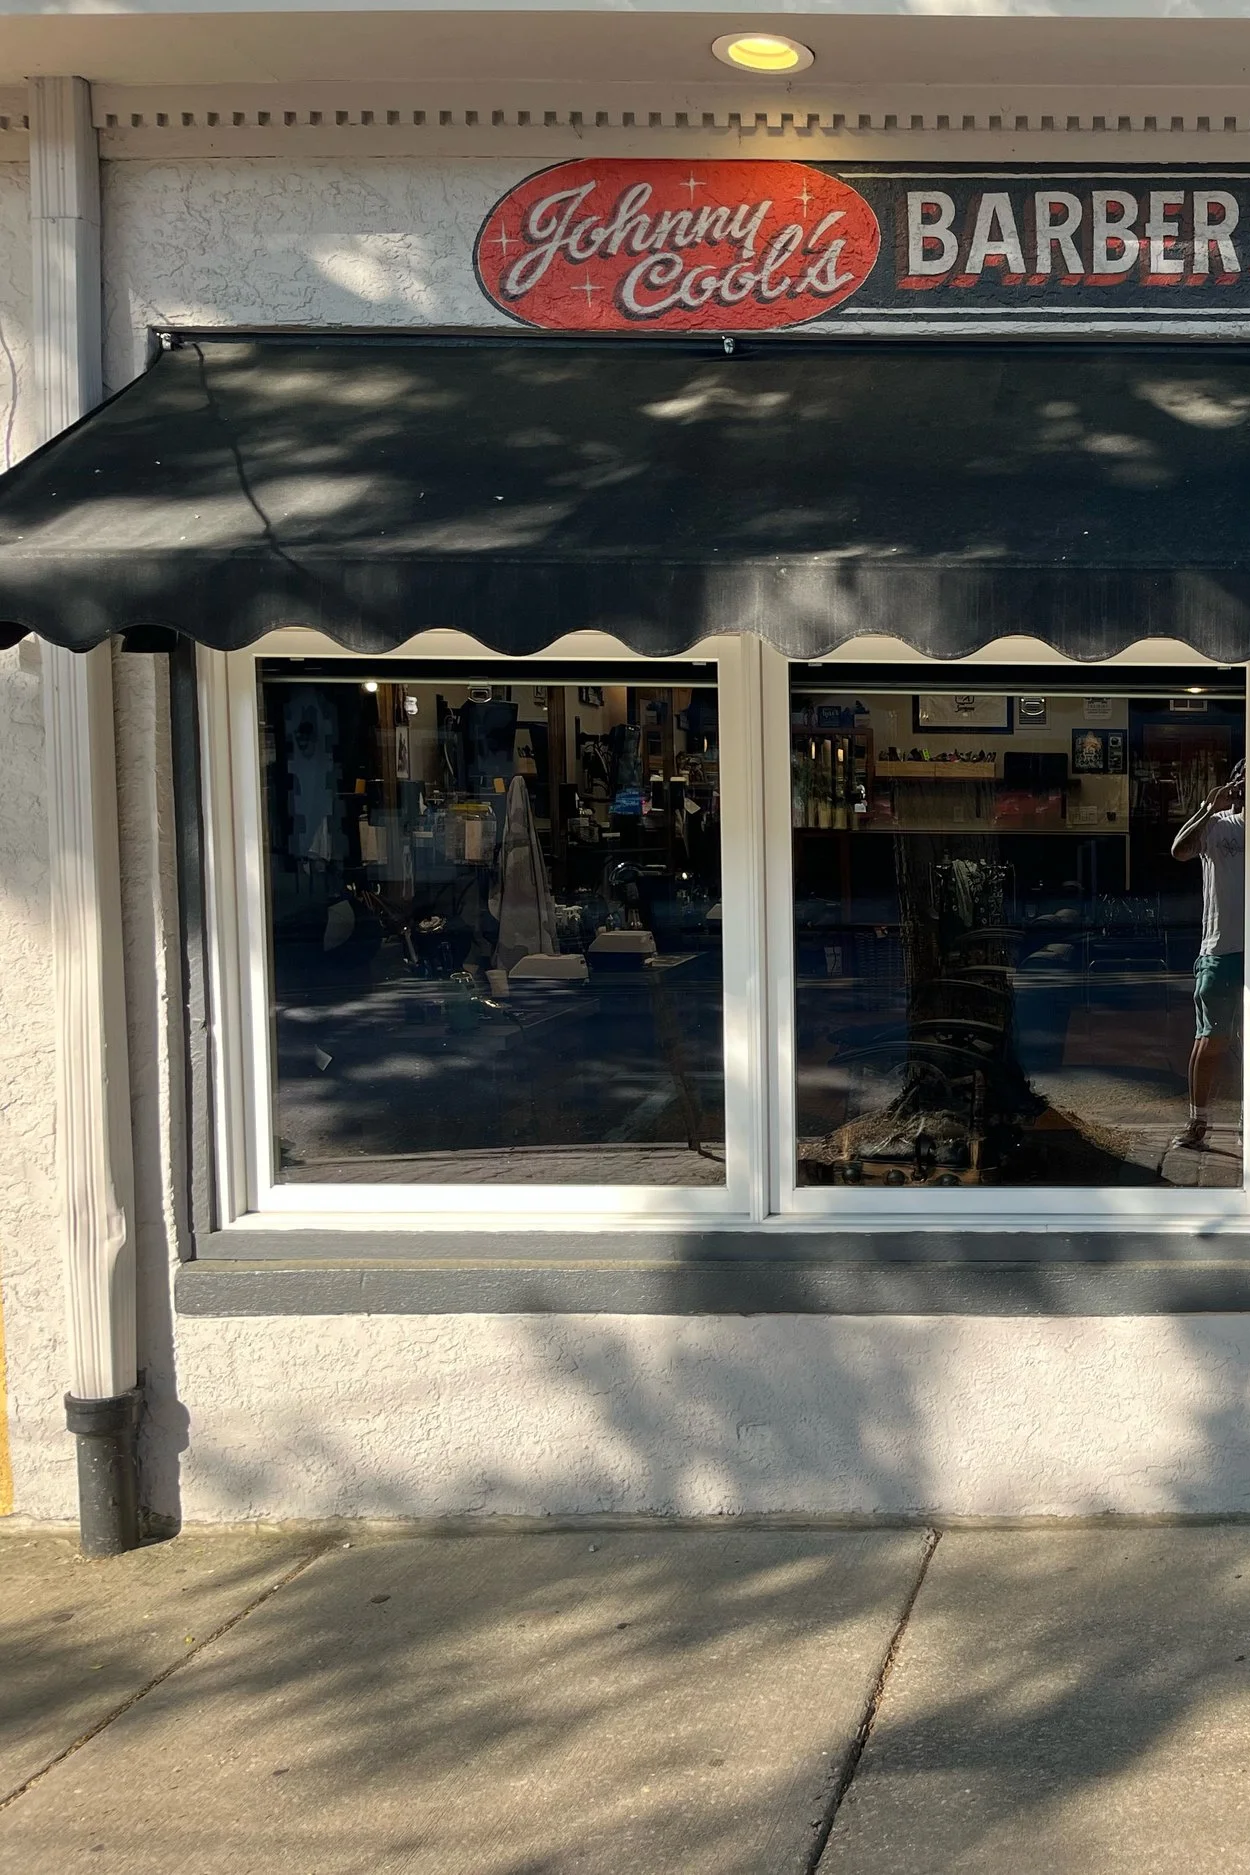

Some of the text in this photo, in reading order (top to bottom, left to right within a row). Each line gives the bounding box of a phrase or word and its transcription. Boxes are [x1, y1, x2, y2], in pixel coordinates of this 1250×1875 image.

[505, 179, 773, 296] Johnny
[621, 210, 855, 315] Cool's
[906, 189, 1241, 277] BARBER
